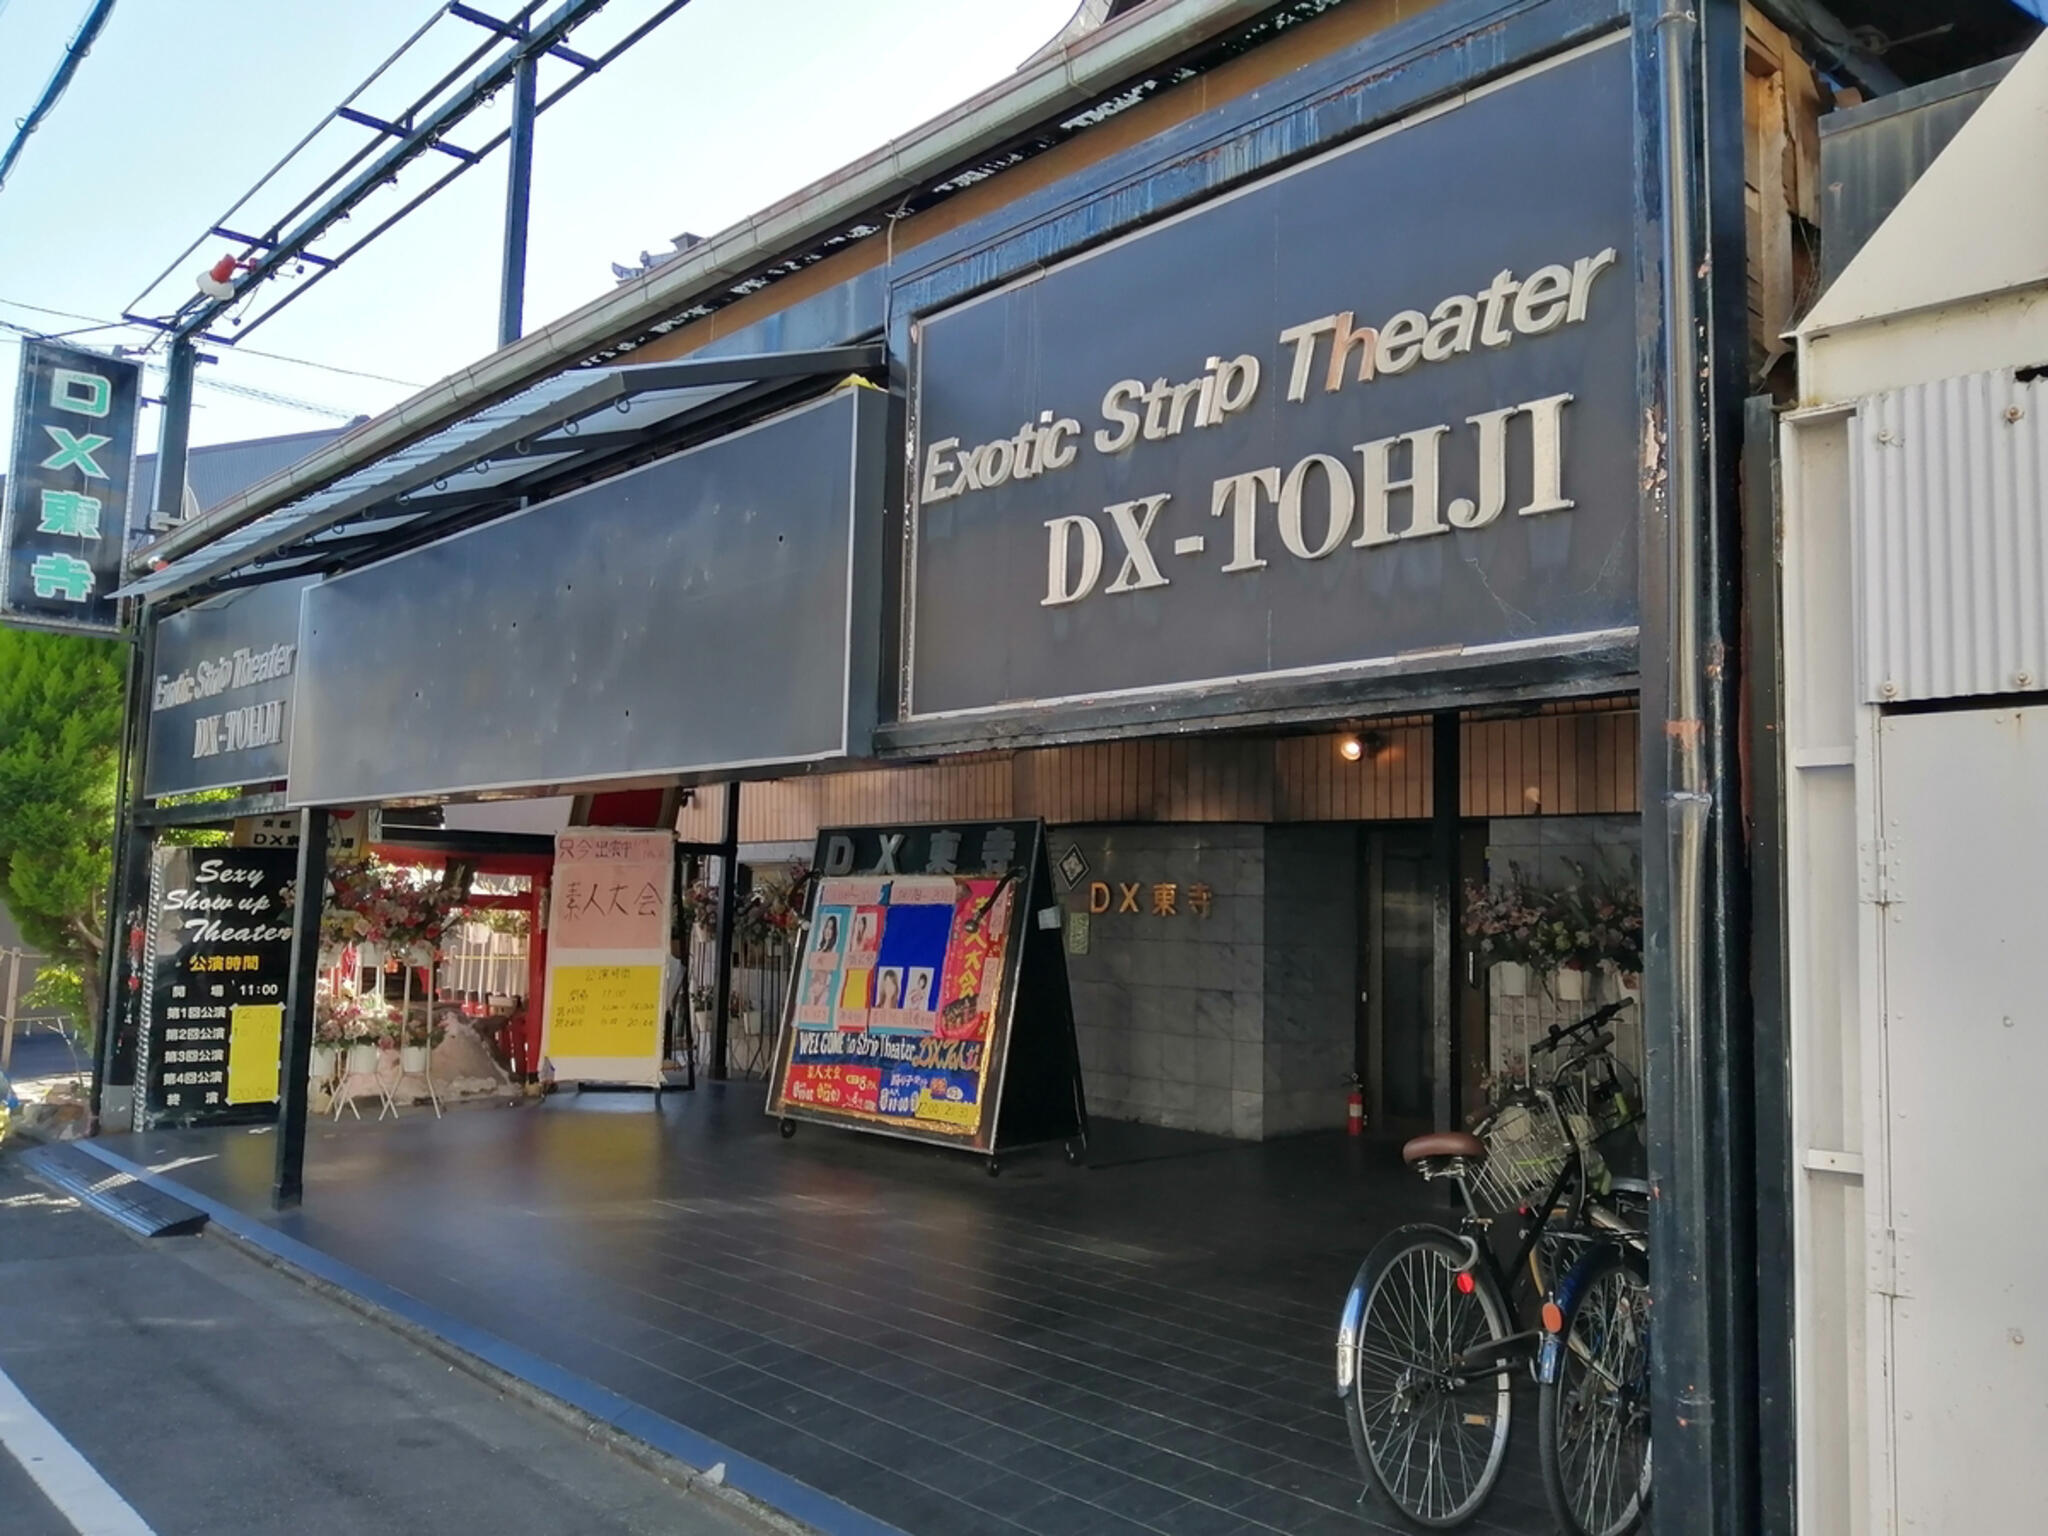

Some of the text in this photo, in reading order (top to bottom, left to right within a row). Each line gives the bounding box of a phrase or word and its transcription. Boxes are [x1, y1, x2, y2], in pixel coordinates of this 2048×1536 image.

[920, 247, 1618, 505] Exotic Strip Theater
[1040, 391, 1576, 608] DX-TOHJI
[152, 643, 298, 712] Exotic Strip Theater
[192, 700, 286, 759] DX-TOHJI
[195, 858, 265, 889] Sexy
[163, 888, 271, 915] Show up
[565, 881, 663, 922] 素人大会
[184, 917, 295, 944] Theater
[188, 954, 261, 973] 公演時間
[239, 983, 279, 996] 11:00
[166, 1006, 227, 1020] 第1回公演
[165, 1027, 226, 1042] 第2回公演
[163, 1049, 225, 1064] 第3回公演
[163, 1071, 224, 1086] 第4回公演
